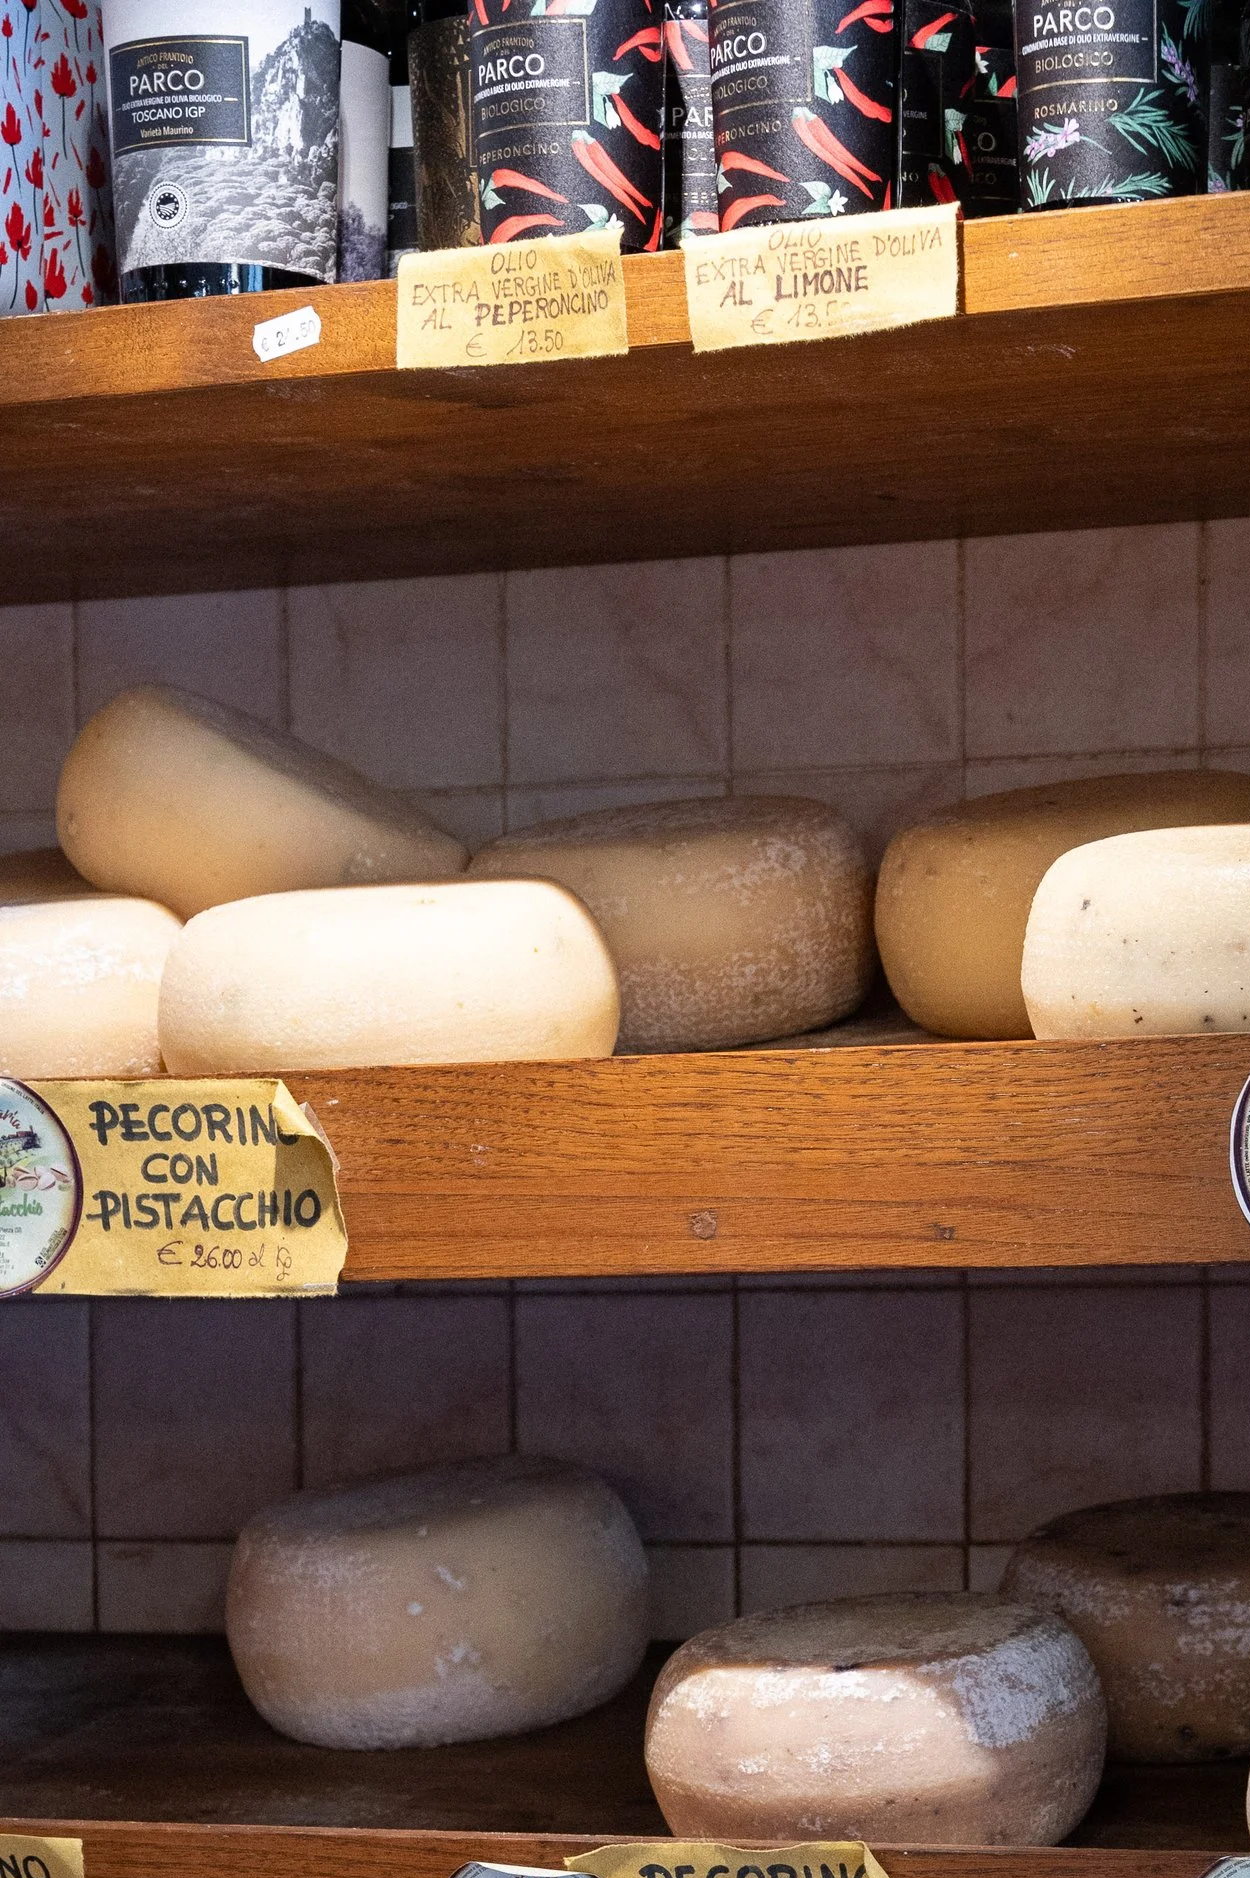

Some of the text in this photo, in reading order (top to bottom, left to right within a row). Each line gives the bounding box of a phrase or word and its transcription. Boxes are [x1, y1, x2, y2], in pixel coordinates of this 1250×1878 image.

[1033, 6, 1115, 38] PARCO
[502, 37, 535, 49] FRANTOIO
[710, 31, 767, 69] PARCO
[1053, 36, 1068, 47] BASE
[1076, 34, 1092, 43] OLIO
[1093, 33, 1140, 44] EXTRAVERGINE
[136, 52, 194, 69] ANTICO FRANTOIO
[478, 53, 545, 87] PARCO
[736, 55, 791, 72] OLIO EXTRAVERGINE
[1035, 51, 1114, 73] BIOLOGICO
[129, 69, 205, 97] PARCO
[511, 78, 570, 92] OLIO EXTRAVERGINE
[143, 94, 222, 108] VERGINE OLIVA BIOLOGICO
[481, 97, 545, 121] BIOLOGICO
[1034, 99, 1118, 120] ROSMARINO
[132, 106, 206, 123] TOSCANO IGP
[672, 106, 714, 127] PAR
[140, 125, 194, 138] Varietà Maurino
[479, 142, 560, 167] PEPERONCINO
[768, 225, 822, 250] OLIO
[491, 249, 537, 276] OLIO
[695, 226, 943, 284] EXTRA VERGINE D'OLIVA
[412, 260, 616, 306] EXTRA VERGINE D'OLIVA
[719, 265, 869, 307] AL LIMONE
[421, 289, 609, 331] AL PEPERONCINO
[750, 308, 774, 335] €
[465, 330, 564, 358] € 13.50
[88, 1100, 300, 1147] PECORIN
[140, 1152, 219, 1187] CON
[0, 1193, 43, 1217] acchio
[86, 1188, 323, 1232] PISTACCHIO
[156, 1240, 184, 1267] €
[190, 1243, 244, 1270] 26.00
[274, 1244, 293, 1281] Kg
